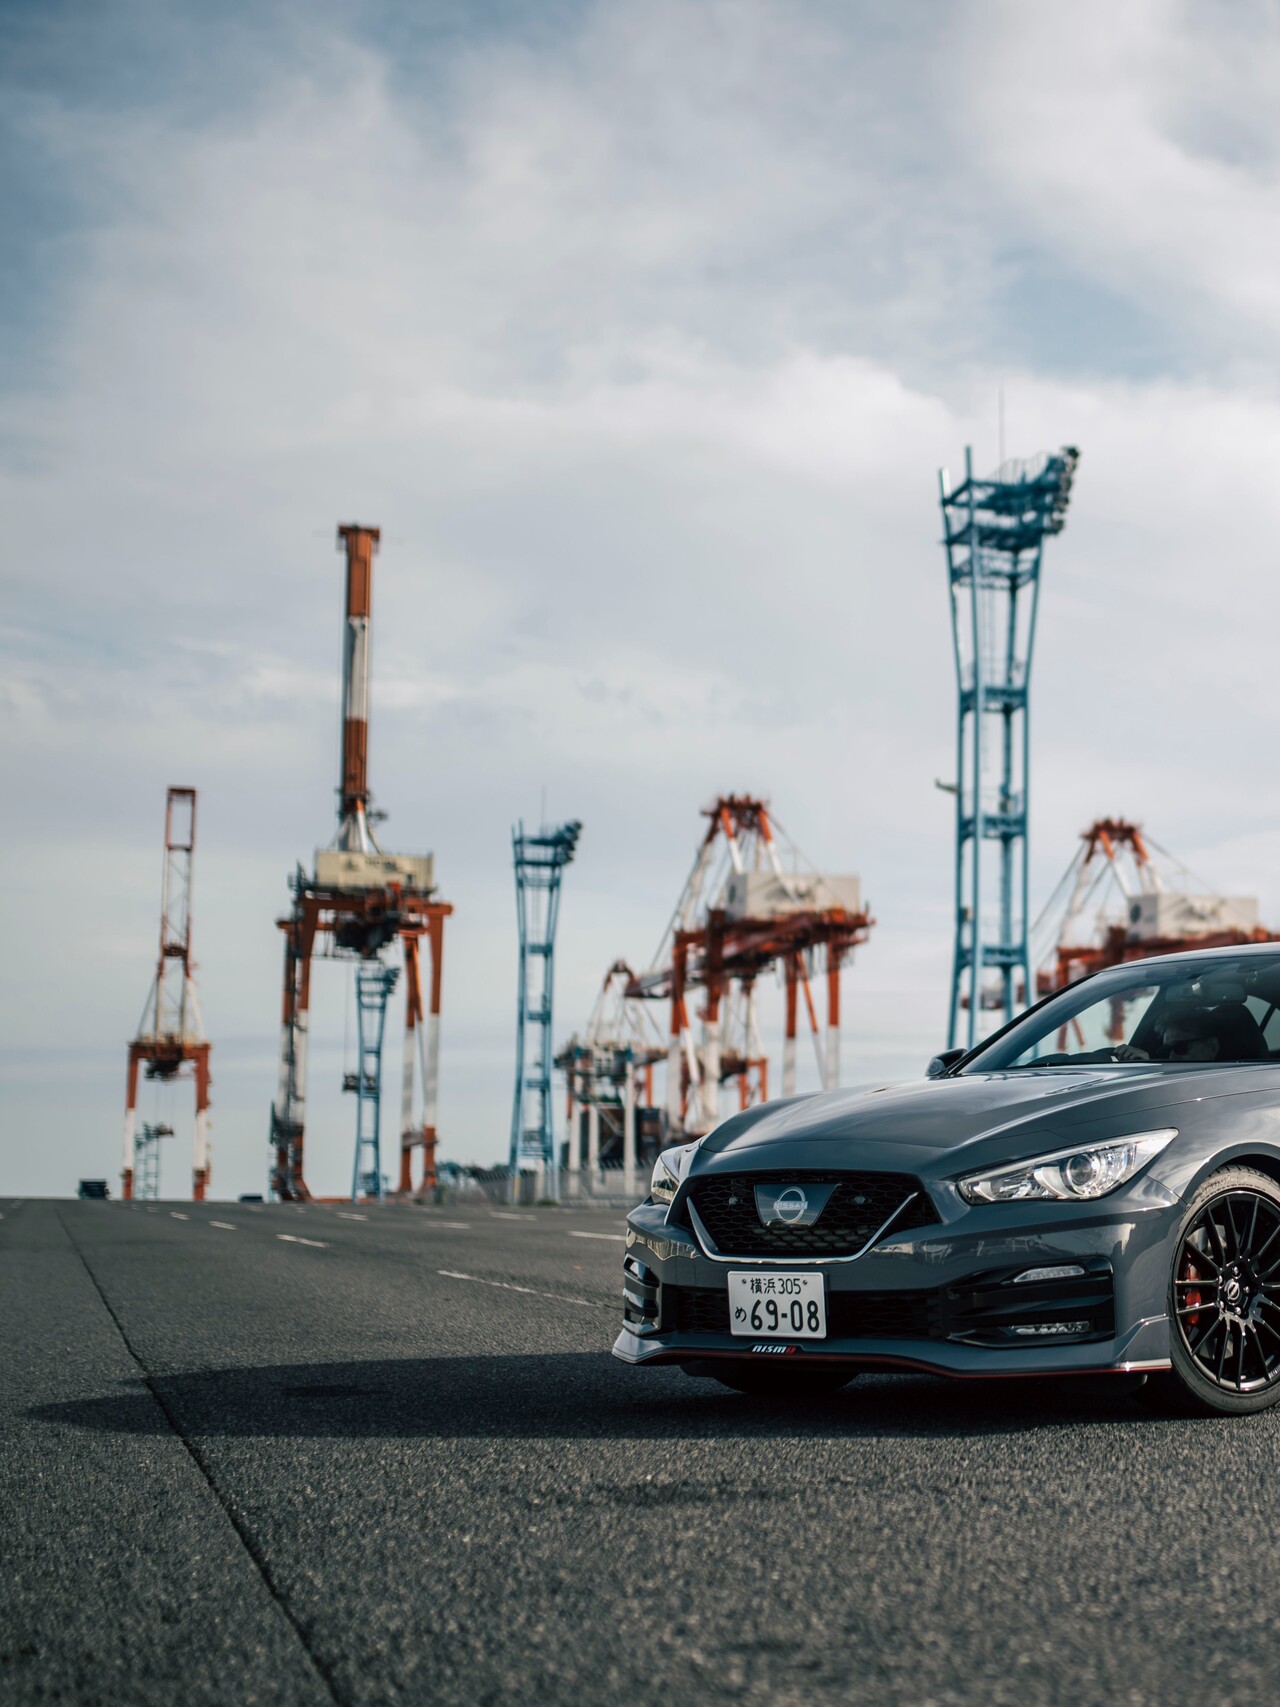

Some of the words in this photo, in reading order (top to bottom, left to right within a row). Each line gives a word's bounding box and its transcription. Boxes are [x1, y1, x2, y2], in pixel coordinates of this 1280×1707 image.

[773, 1202, 808, 1210] NISSAN
[734, 1306, 747, 1323] め
[750, 1299, 820, 1333] 69-08
